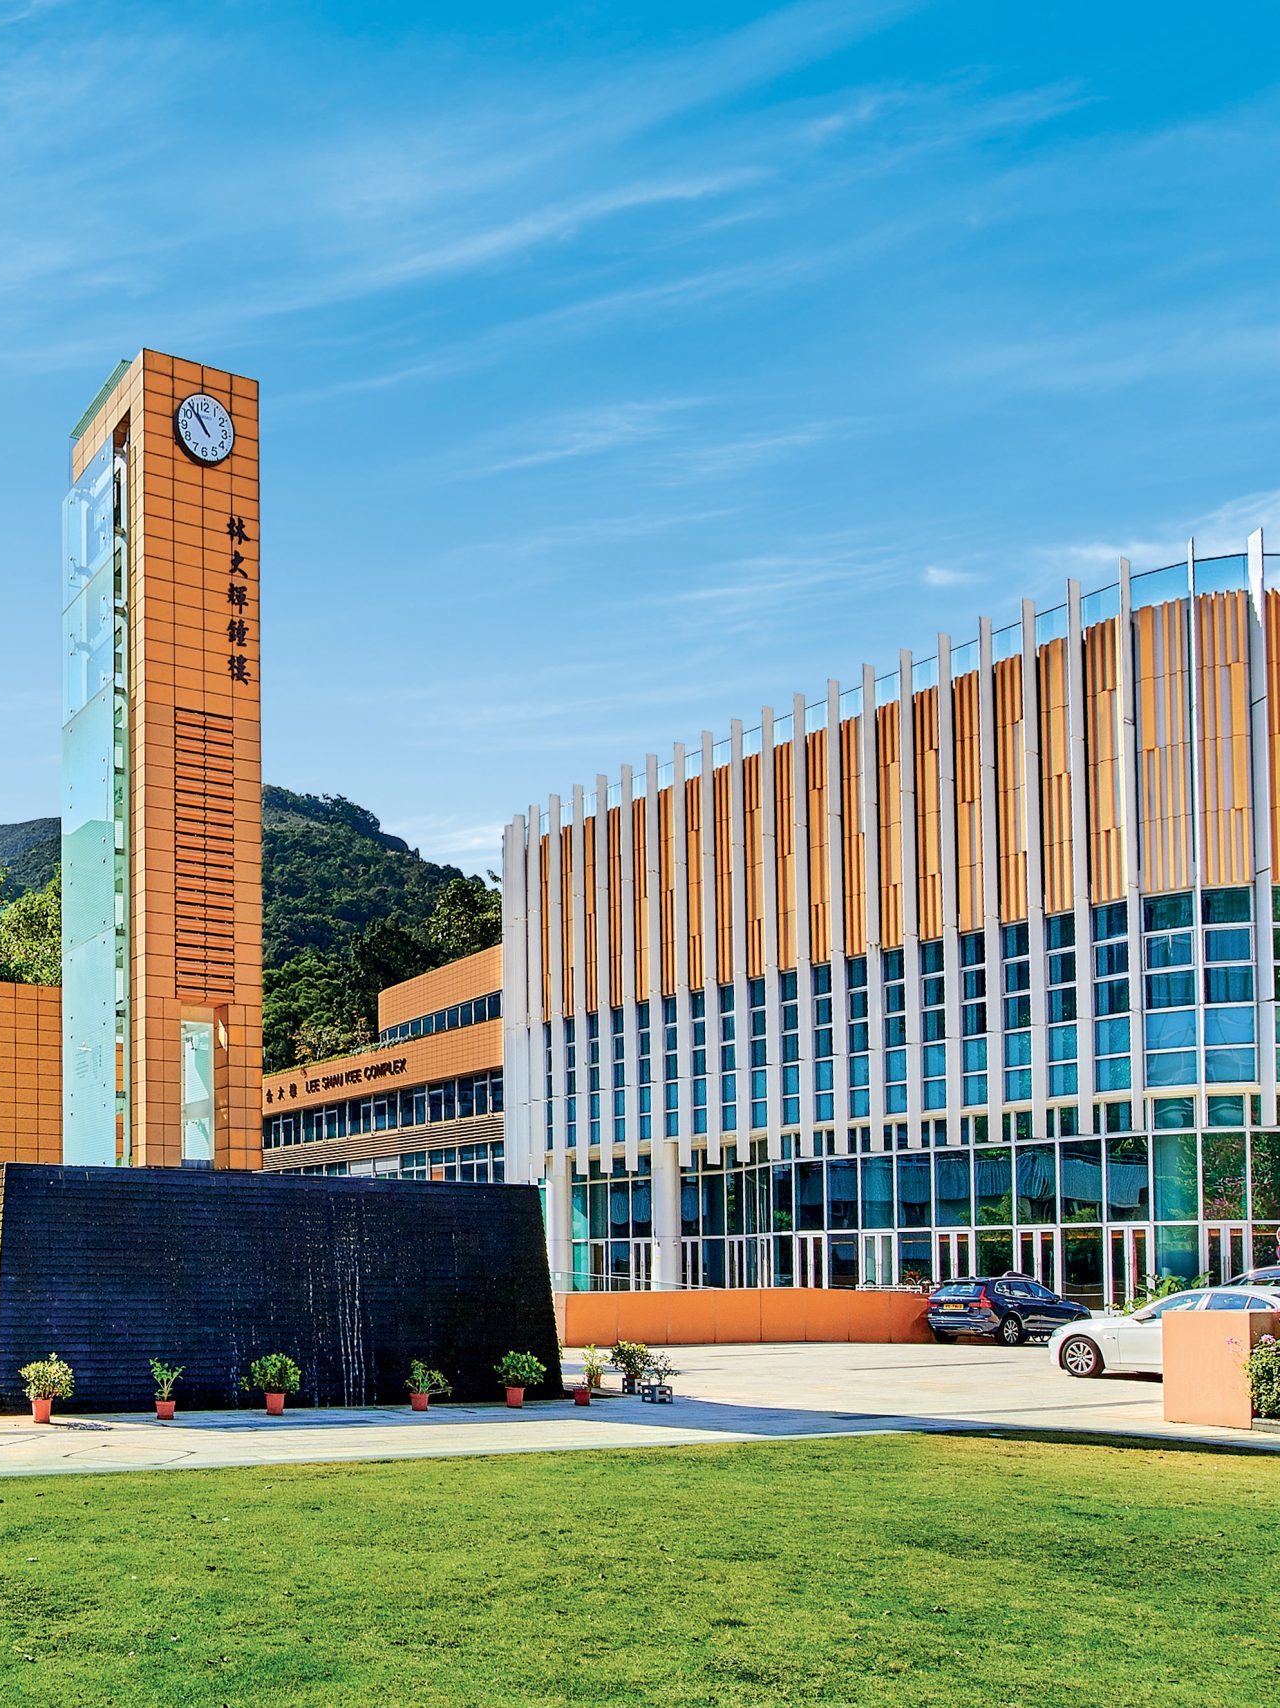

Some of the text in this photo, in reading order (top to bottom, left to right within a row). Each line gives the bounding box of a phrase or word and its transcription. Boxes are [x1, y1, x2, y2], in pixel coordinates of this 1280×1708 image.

[200, 401, 210, 413] 12
[182, 408, 193, 420] 10
[181, 420, 188, 429] 9
[218, 417, 225, 427] 2
[185, 431, 191, 441] 8
[221, 429, 228, 441] 3
[192, 442, 199, 451] 7
[218, 440, 225, 450] 4
[201, 446, 208, 457] 6
[211, 446, 218, 457] 5
[226, 516, 251, 686] 林大輝鐘樓
[305, 1058, 407, 1095] LEE SHAU KEE COMPLEX
